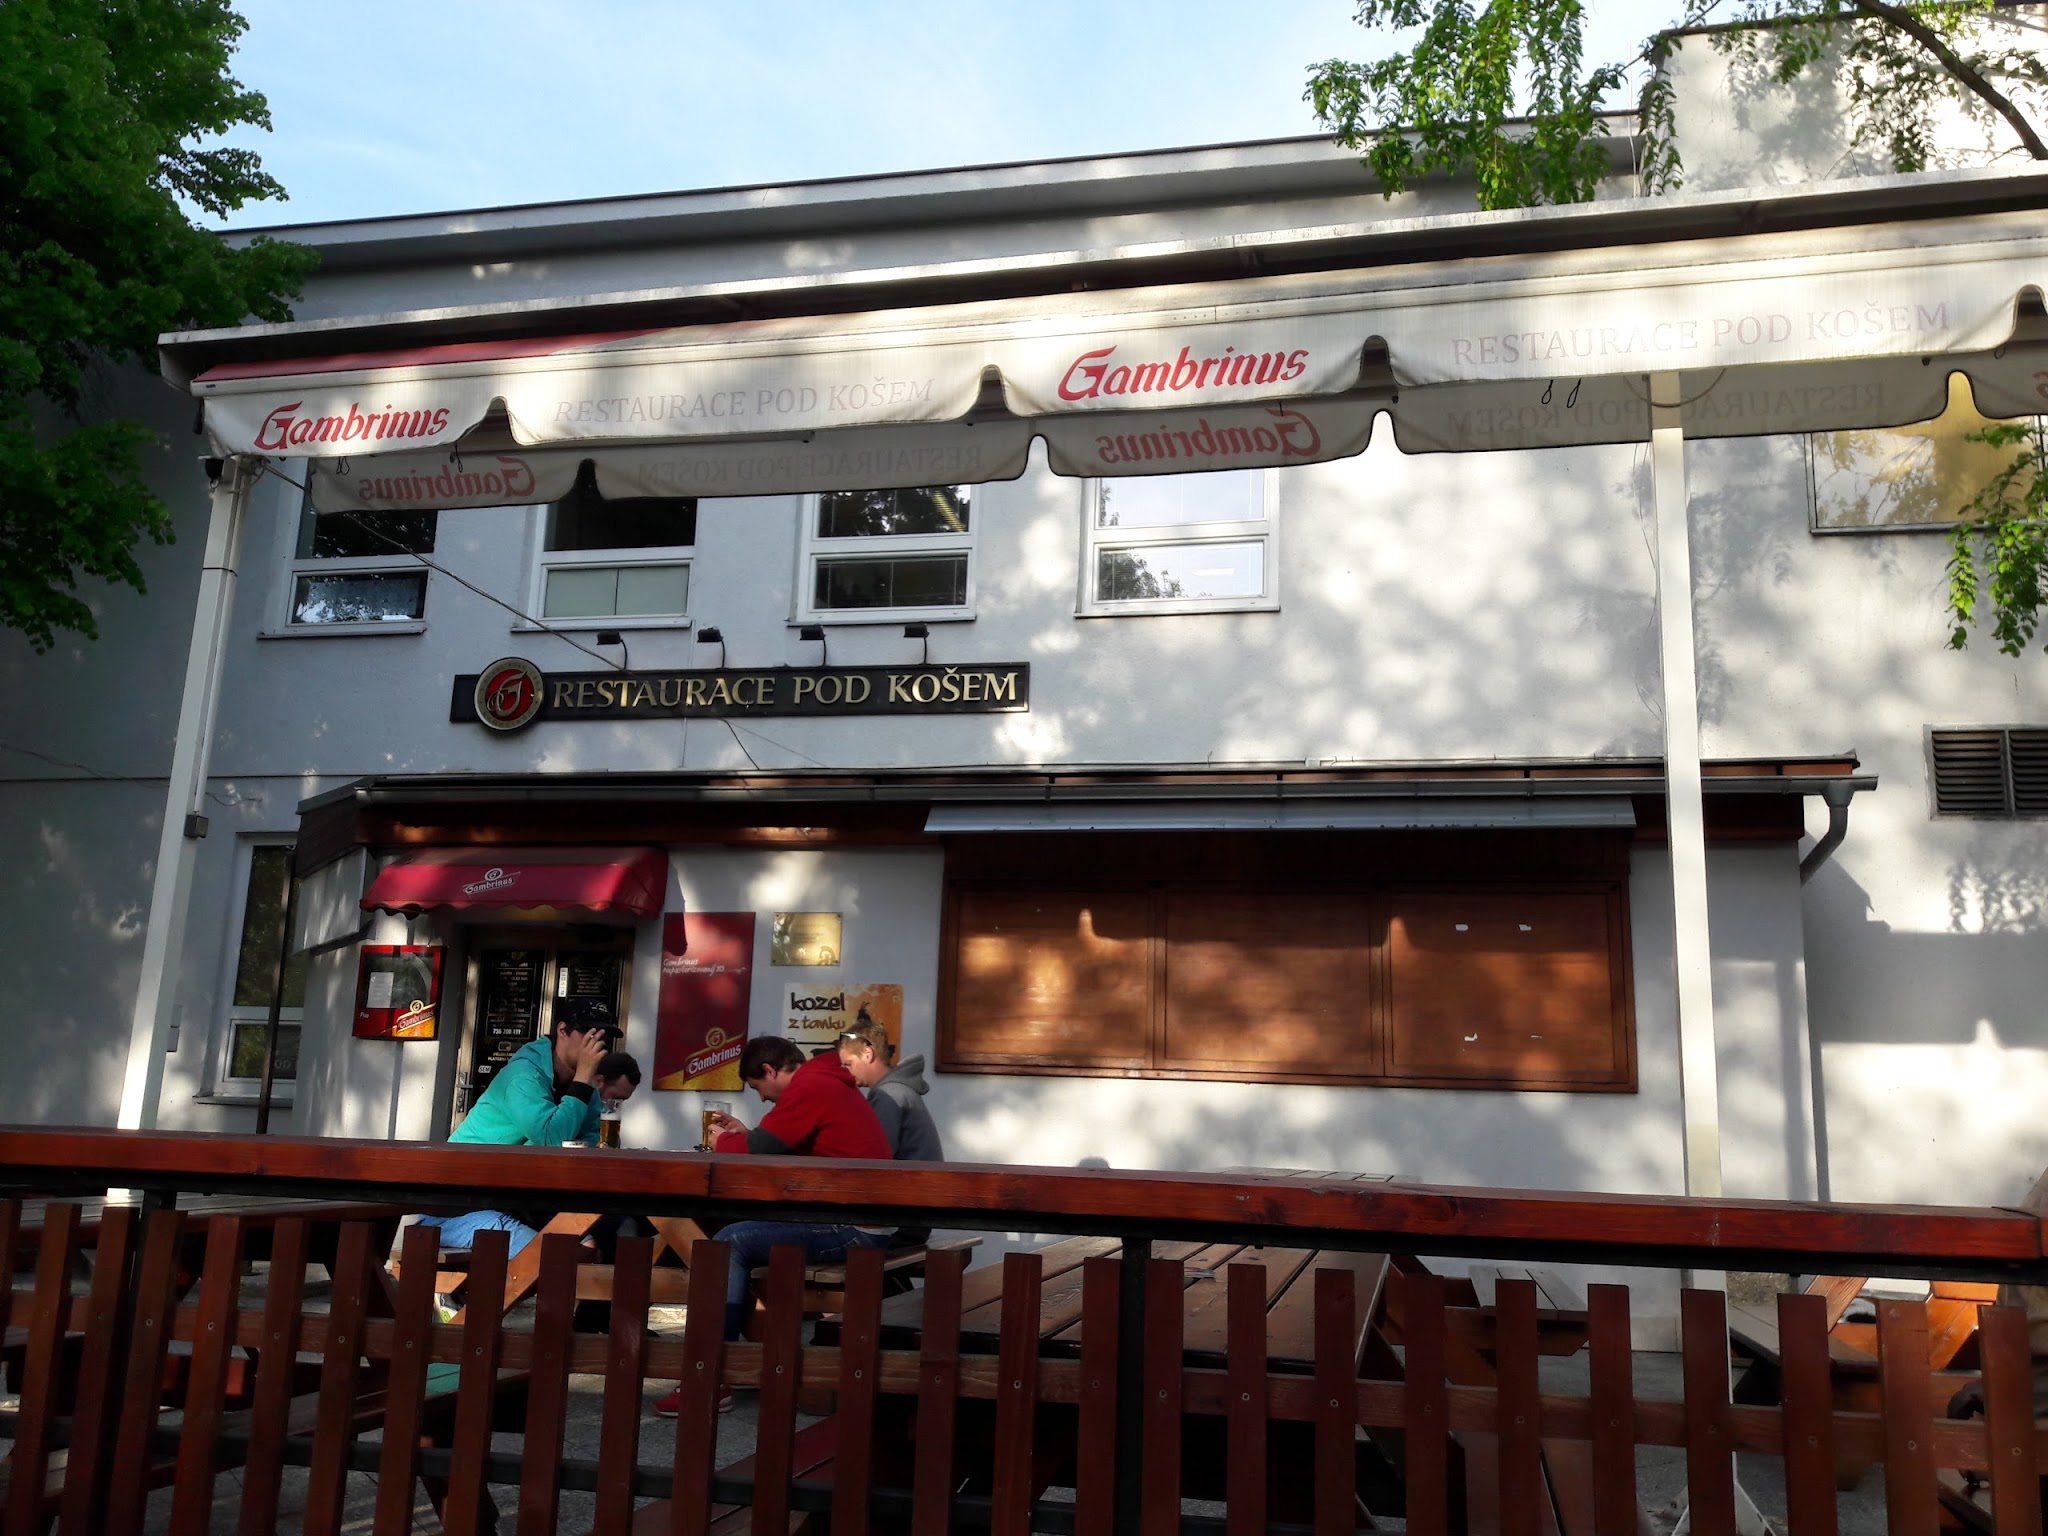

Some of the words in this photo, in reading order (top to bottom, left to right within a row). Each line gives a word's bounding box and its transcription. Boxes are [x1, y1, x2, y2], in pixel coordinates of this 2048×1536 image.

[1453, 321, 1698, 366] RESTAURACE
[1712, 314, 1792, 347] POD
[1807, 301, 1950, 340] KOŠEM
[1058, 345, 1309, 401] Gambrinus
[554, 391, 745, 423] RESTAURACE
[757, 387, 818, 416] POD
[827, 376, 935, 411] KOŠEM
[254, 401, 450, 450] Gambrinus
[553, 676, 776, 709] RESTAURACE
[793, 675, 871, 705] POD
[888, 667, 1018, 703] KOŠEM
[465, 877, 513, 894] Gambrinus
[791, 991, 846, 1011] kozel
[398, 1010, 434, 1029] Gambrinus
[788, 1017, 799, 1029] z
[801, 1015, 846, 1030] tanku
[479, 1066, 491, 1074] SEM
[688, 1044, 742, 1074] Gambrinus
